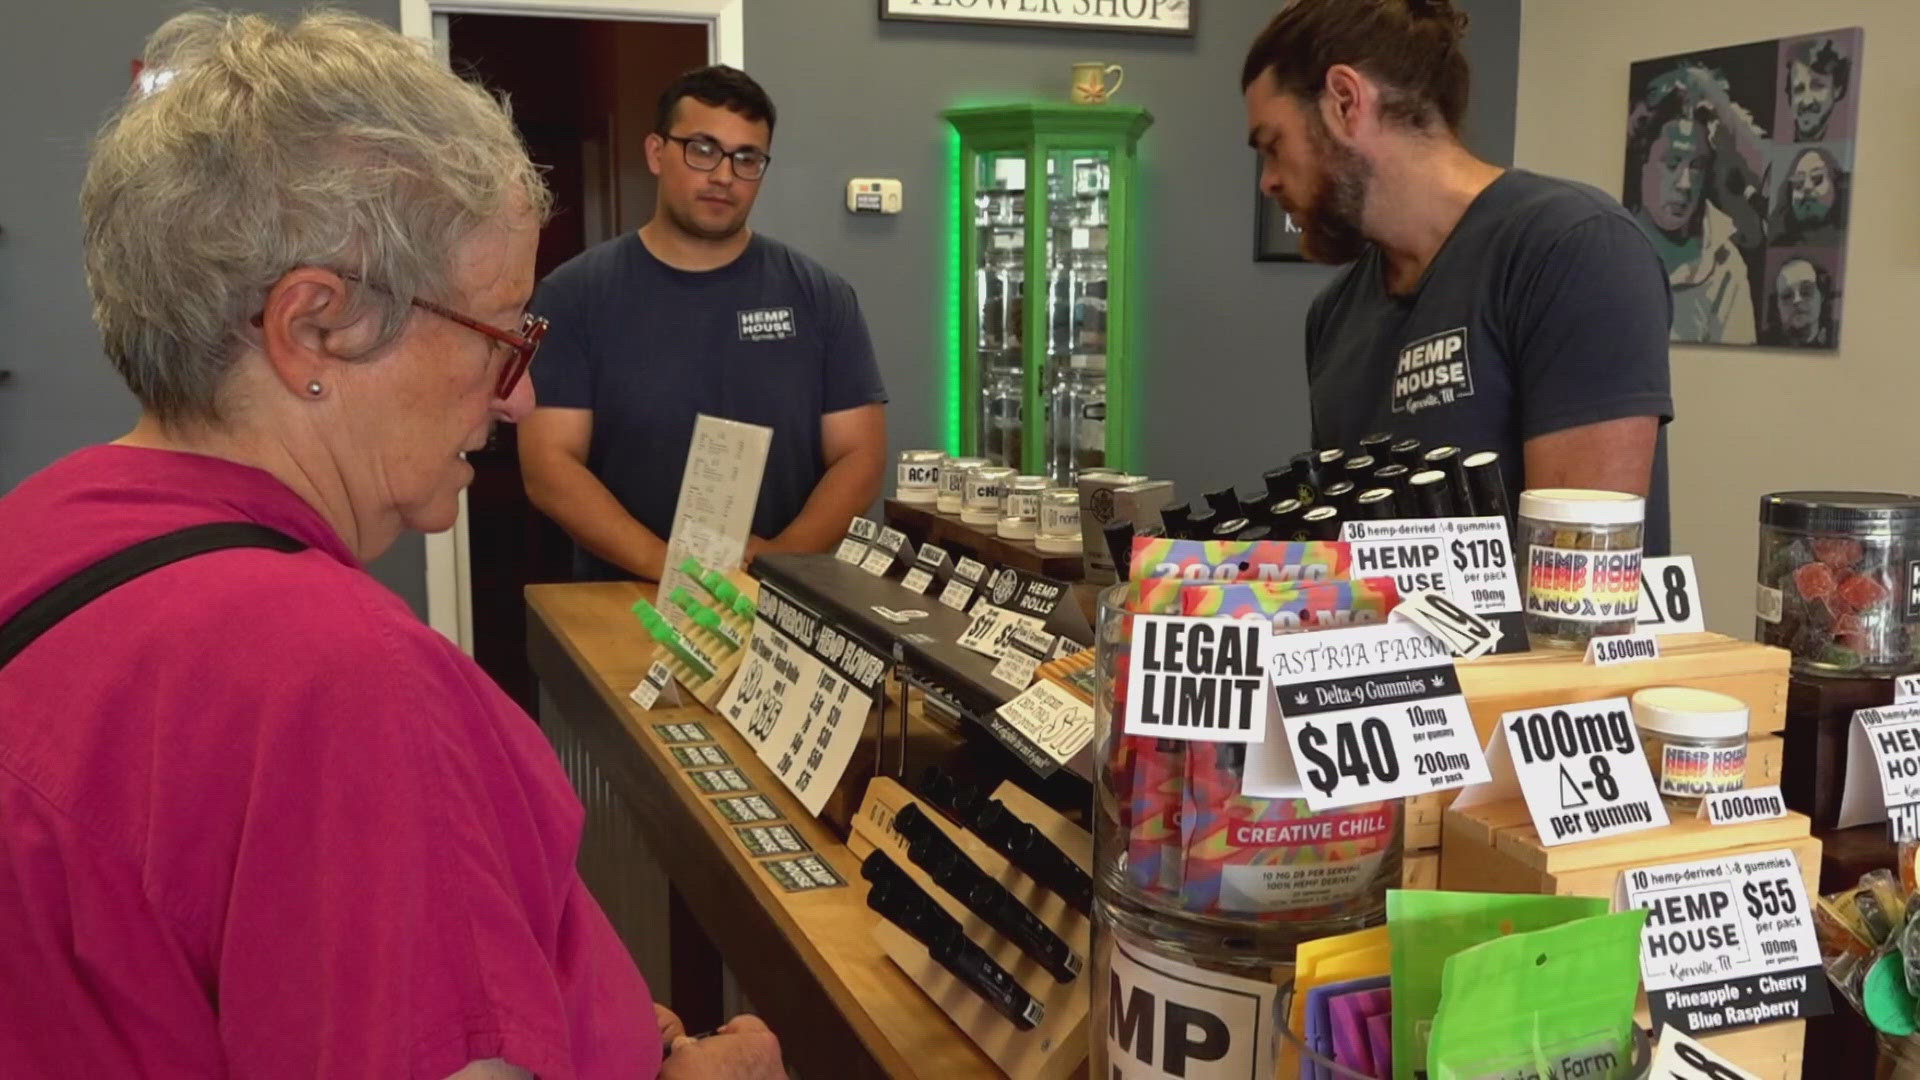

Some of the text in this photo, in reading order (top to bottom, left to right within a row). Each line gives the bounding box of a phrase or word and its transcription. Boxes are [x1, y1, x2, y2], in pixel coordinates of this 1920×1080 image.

[741, 310, 789, 324] HEMP
[743, 321, 792, 334] HOUSE
[1397, 335, 1462, 374] HEMP
[1395, 362, 1465, 398] HOUSE
[1348, 522, 1366, 539] 36
[1367, 523, 1436, 538] hemp-derived
[1456, 519, 1502, 535] gummies
[1357, 544, 1440, 571] HEMP
[1450, 538, 1507, 573] $179
[1028, 581, 1059, 599] HEMP
[1463, 570, 1508, 585] per pack
[1020, 595, 1055, 614] ROLLS
[1470, 588, 1506, 603] 100mg
[815, 624, 847, 663] HEMP
[840, 640, 886, 690] FLOWER
[1142, 620, 1264, 677] LEGAL
[1271, 641, 1371, 677] ASTRIA
[1596, 638, 1656, 662] 3,600mg
[1140, 674, 1261, 730] LIMIT
[1315, 675, 1427, 706] Delta-9 Gummies
[1405, 705, 1448, 728] 10mg
[1859, 709, 1883, 726] 100
[1412, 727, 1455, 743] per gummy
[1509, 709, 1635, 765] 100mg
[1296, 716, 1400, 798] $40
[1414, 750, 1471, 776] 200mg
[1430, 772, 1464, 788] per pack
[1549, 800, 1653, 840] per gummy
[1710, 795, 1782, 821] 1,000mg
[1236, 816, 1385, 843] CREATIVE CHILL
[1307, 868, 1324, 877] PER
[1632, 870, 1649, 890] 10
[1651, 866, 1723, 884] hemp-derived
[1744, 857, 1792, 875] gummies
[1641, 891, 1729, 928] HEMP
[1742, 877, 1798, 922] $55
[1755, 915, 1803, 936] per pack
[1648, 923, 1740, 958] HOUSE
[1760, 938, 1799, 955] 100mg
[1664, 973, 1808, 1010] Pineapple Cherry
[1687, 999, 1799, 1031] Blue Raspberry
[1561, 1051, 1619, 1080] Farm
